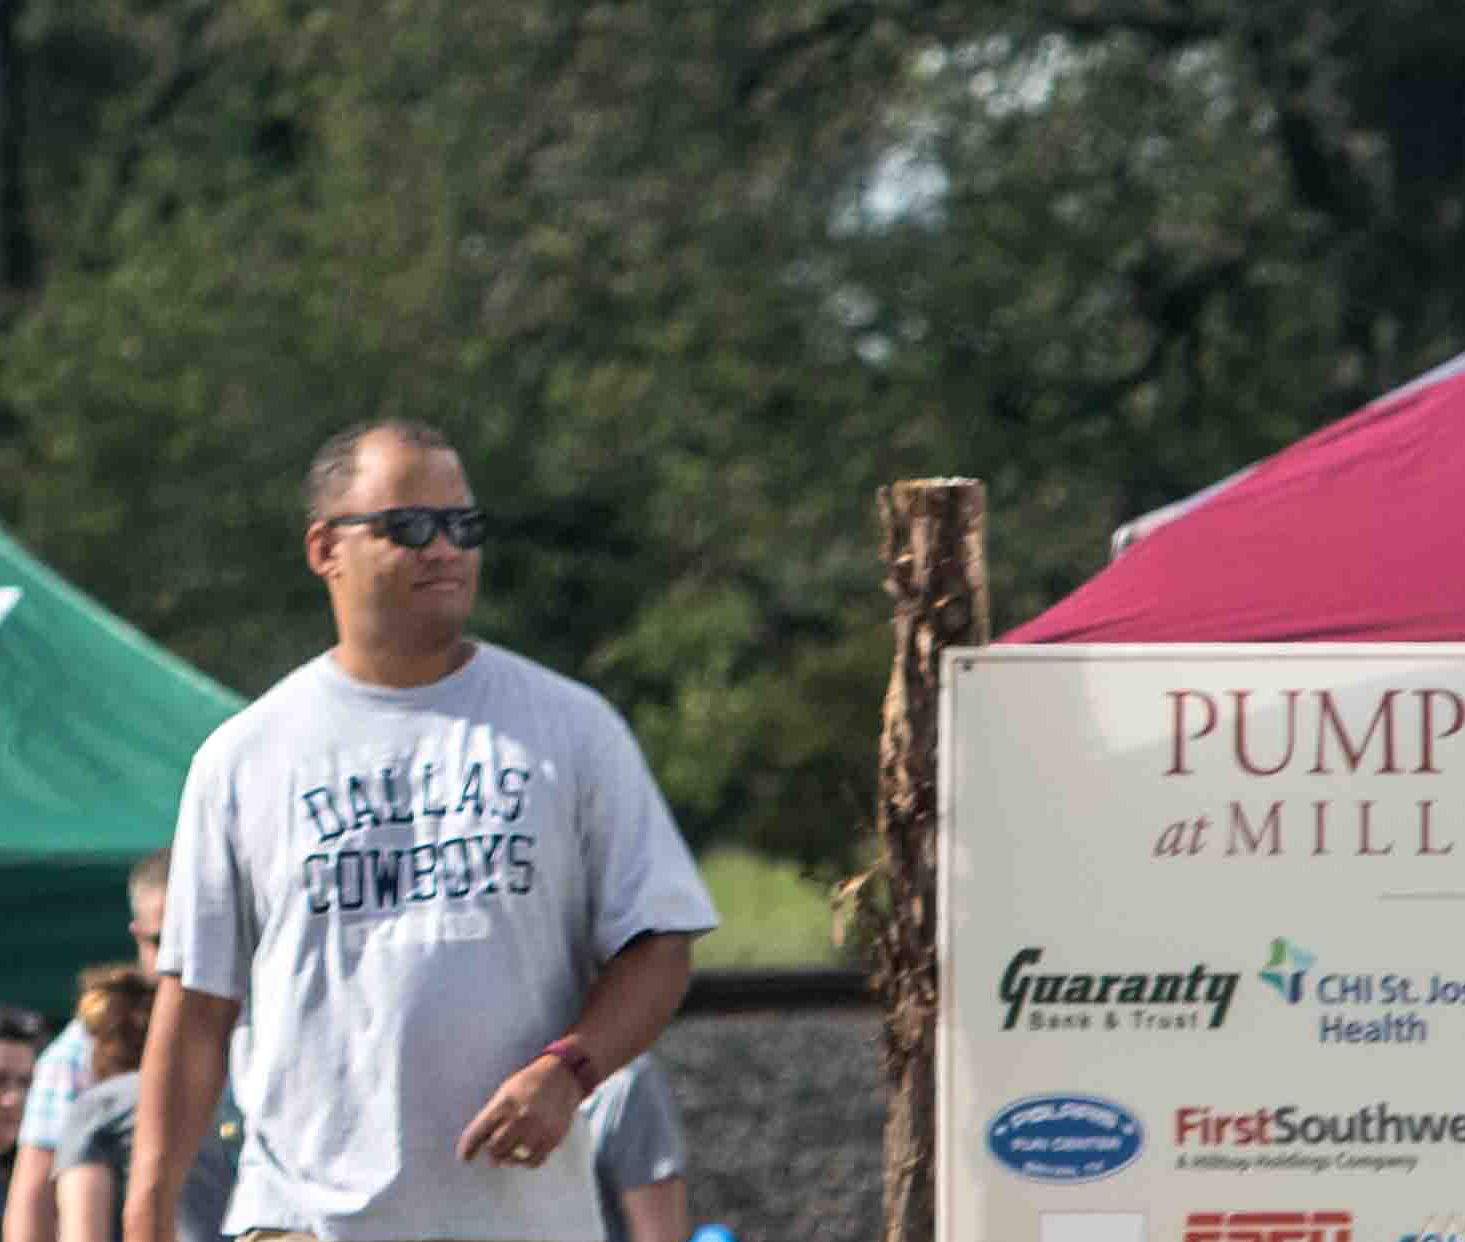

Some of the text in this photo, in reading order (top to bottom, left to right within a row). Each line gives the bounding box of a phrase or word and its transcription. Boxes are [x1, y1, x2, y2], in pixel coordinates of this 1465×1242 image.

[302, 762, 531, 843] DALLAS
[1153, 815, 1213, 858] at
[302, 833, 536, 914] COWBOYS
[1000, 946, 1241, 1031] Guaranty
[1317, 973, 1373, 1004] CHI
[1028, 1008, 1200, 1031] Bank & Trust
[1318, 1011, 1429, 1043] Health
[1336, 1152, 1420, 1174] Company
